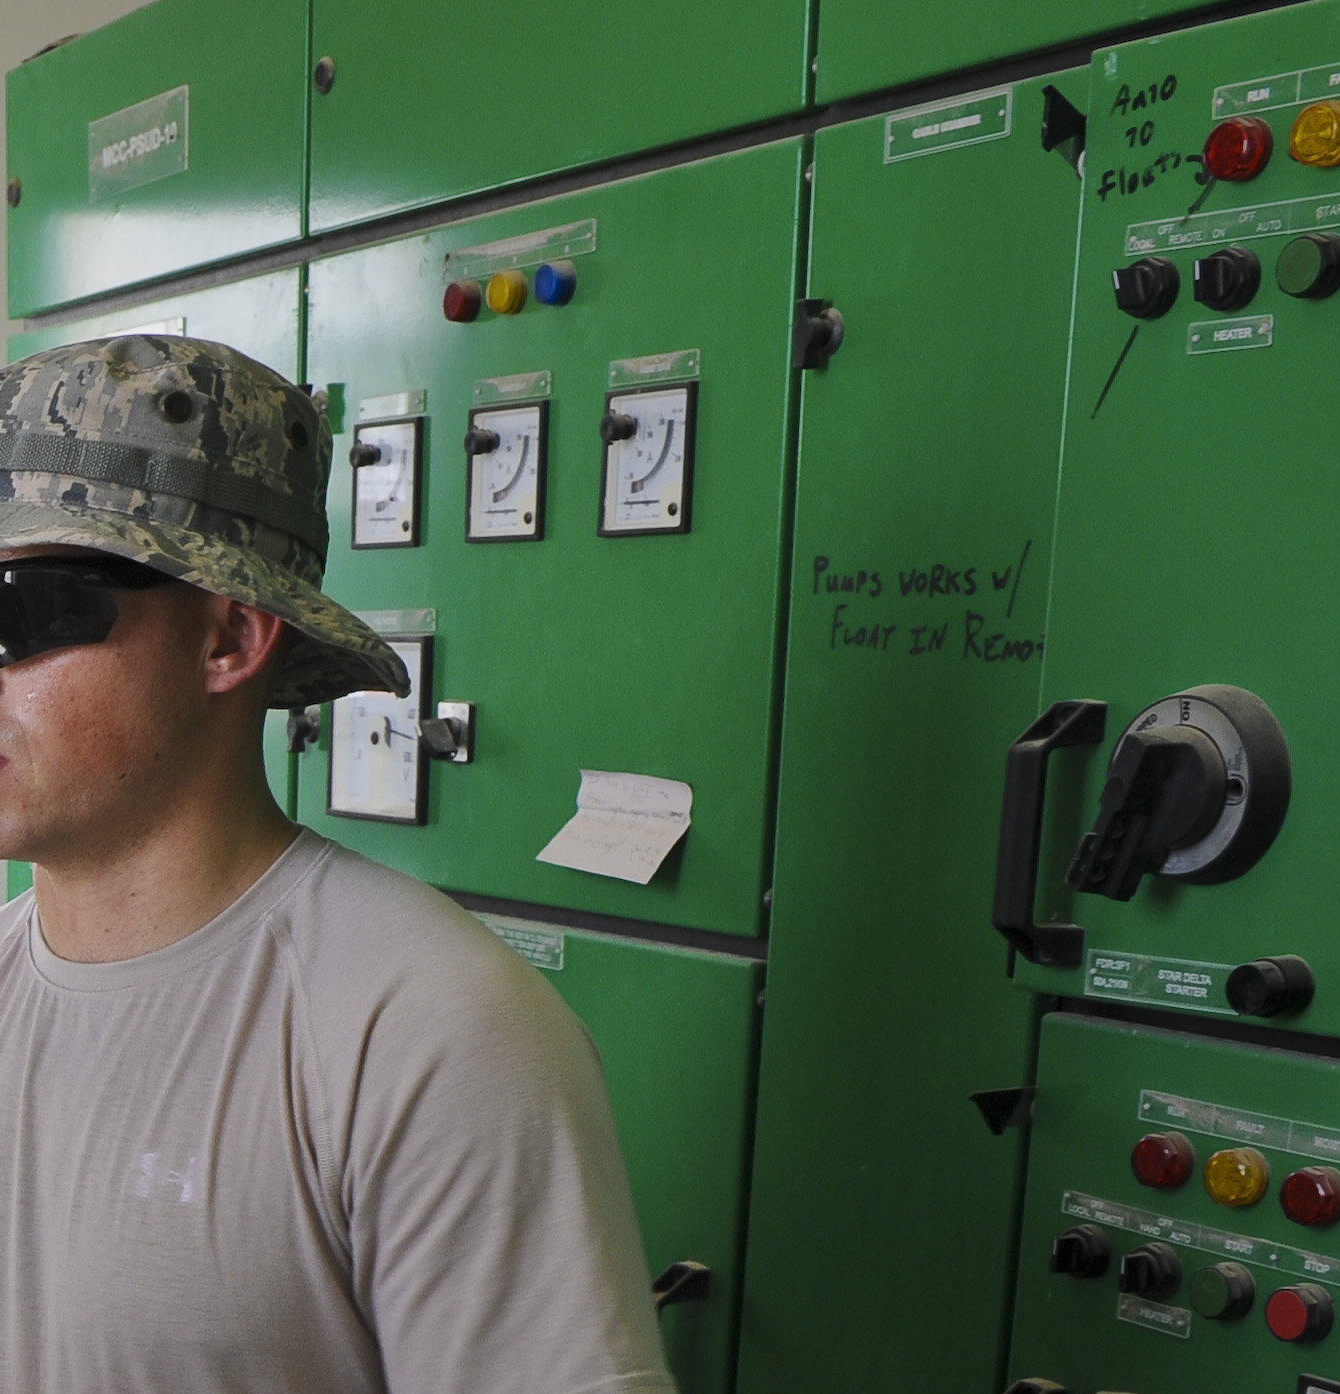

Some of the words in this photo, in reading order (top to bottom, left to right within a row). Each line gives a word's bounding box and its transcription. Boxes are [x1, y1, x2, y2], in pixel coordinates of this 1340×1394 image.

[1247, 88, 1270, 103] RUN
[1256, 219, 1282, 233] AUTO
[1213, 326, 1253, 342] HEATER
[1164, 983, 1208, 999] STARTER
[1170, 1230, 1192, 1245] AUTO
[1225, 1238, 1254, 1256] START
[1304, 1259, 1331, 1275] STOP
